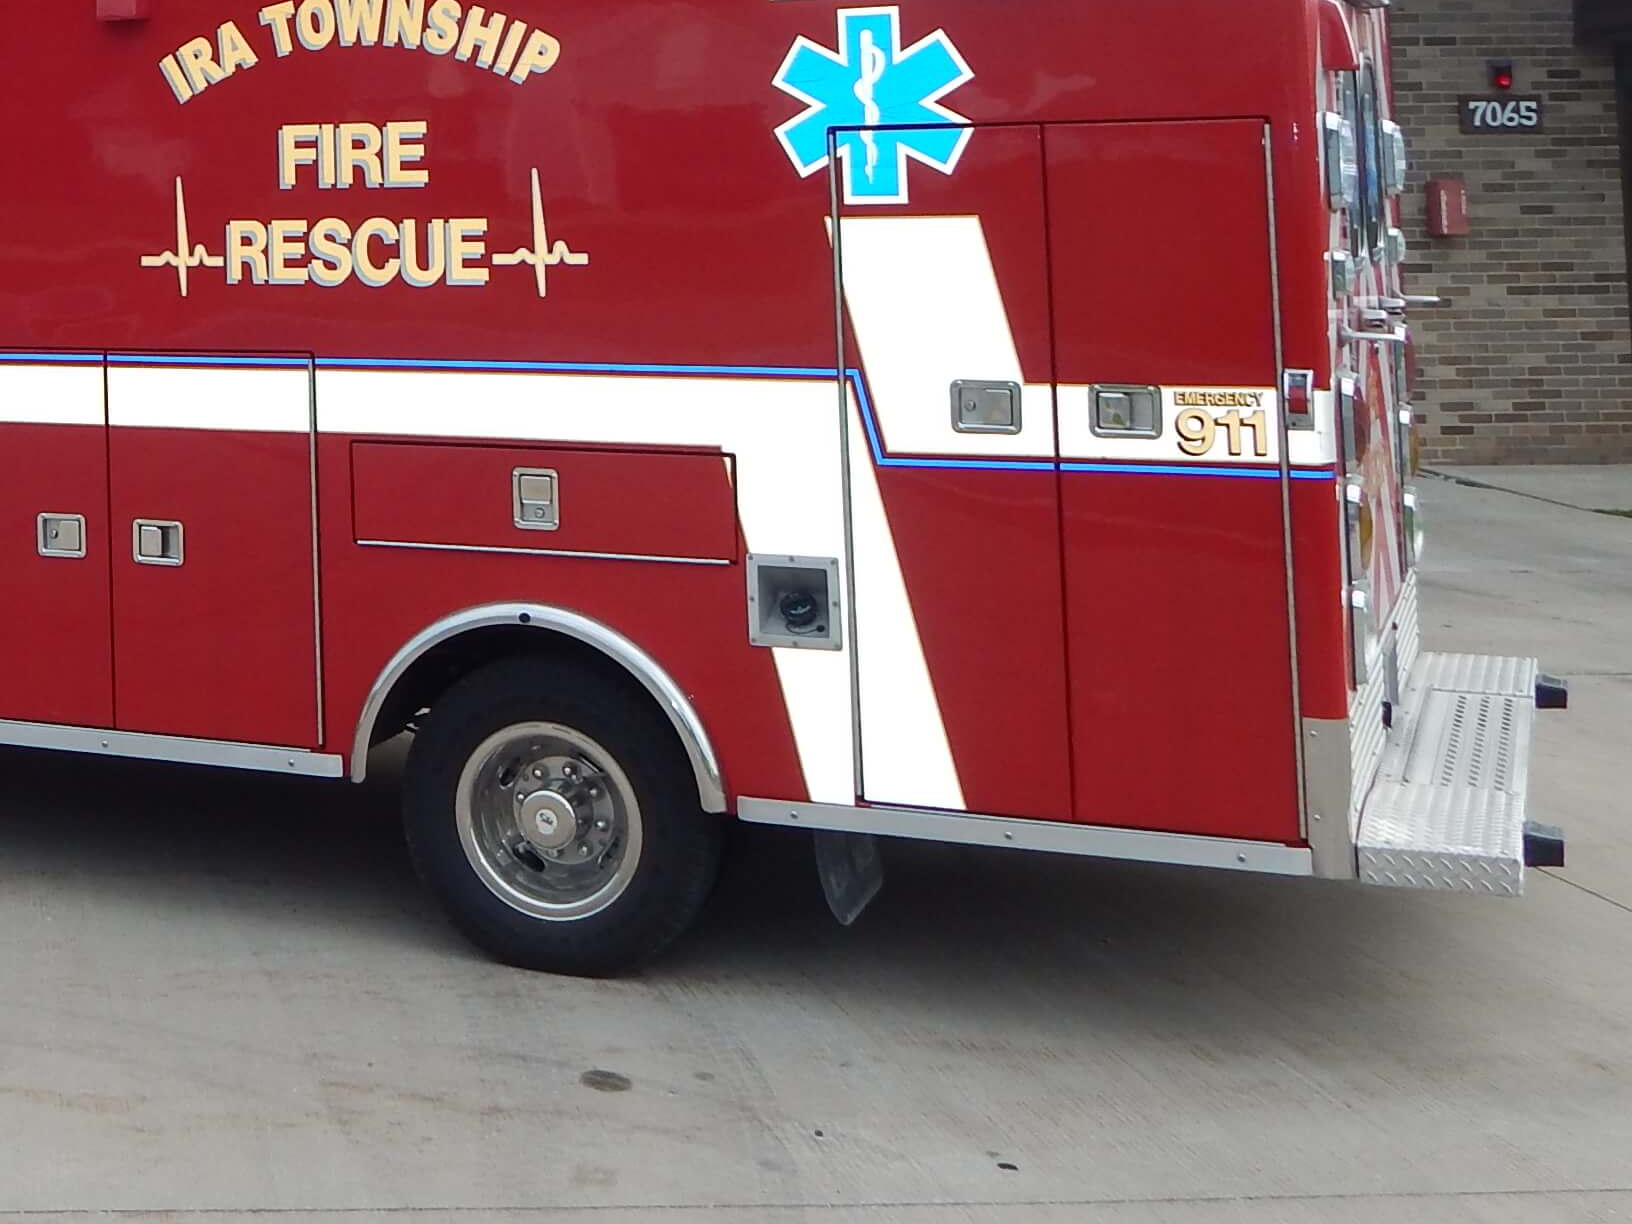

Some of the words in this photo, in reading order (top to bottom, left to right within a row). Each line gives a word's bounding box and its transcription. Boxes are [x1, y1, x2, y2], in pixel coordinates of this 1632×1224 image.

[159, 20, 258, 104] IRA
[1468, 101, 1537, 126] 7065
[278, 120, 429, 190] FIRE
[226, 218, 490, 287] RESCUE
[1174, 391, 1264, 407] EMERGENCY
[1175, 408, 1268, 456] 911
